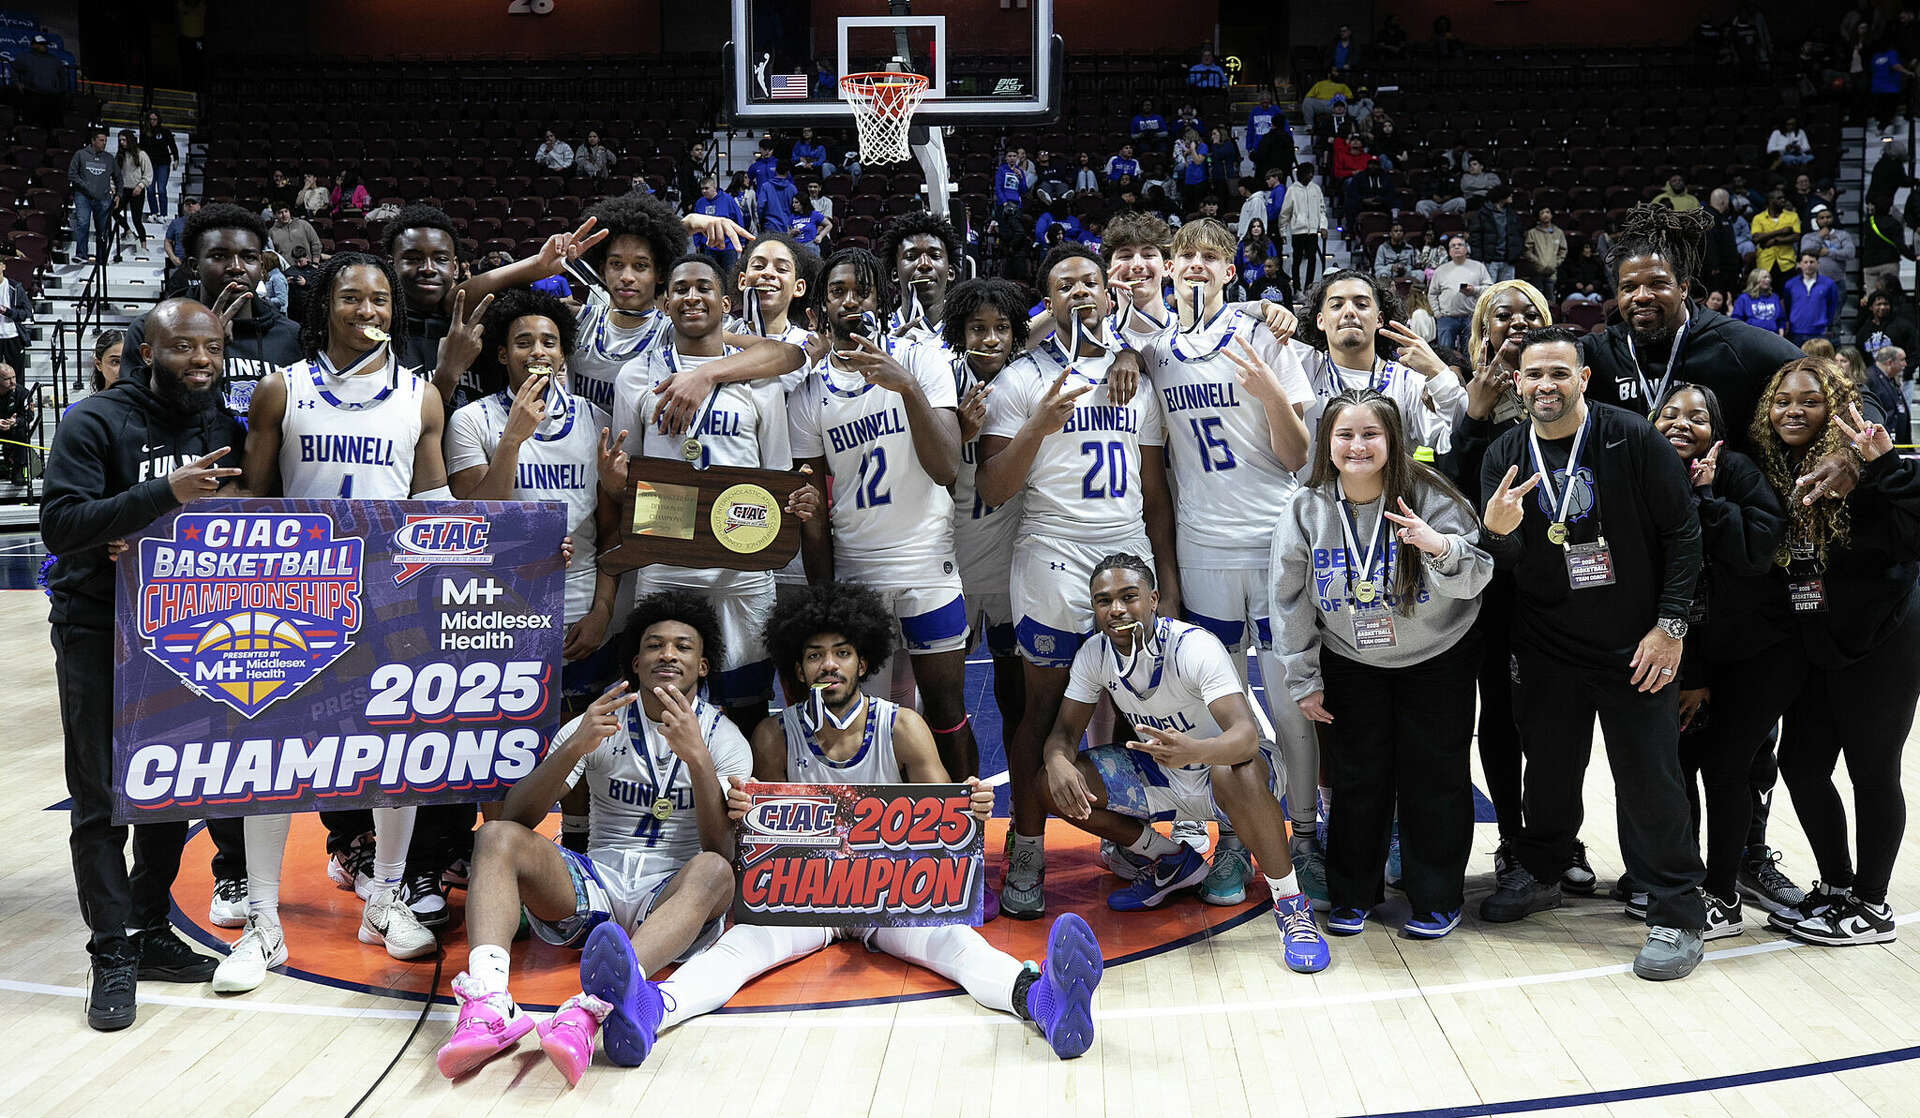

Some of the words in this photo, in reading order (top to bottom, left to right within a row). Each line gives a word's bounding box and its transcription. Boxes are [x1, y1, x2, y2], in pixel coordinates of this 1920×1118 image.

[1163, 382, 1240, 413] BUNNELL
[826, 407, 905, 454] BUNNELL
[1189, 416, 1237, 473] 15
[299, 435, 394, 467] BUNNELL
[855, 446, 892, 511] 12
[1081, 441, 1127, 500] 20
[733, 506, 768, 520] CIAC
[204, 518, 302, 548] CIAC
[410, 522, 490, 550] CIAC
[153, 546, 354, 578] BASKETBALL
[144, 581, 357, 634] CHAMPIONSHIPS
[441, 611, 552, 630] Middlesex
[1319, 598, 1341, 612] OF
[1795, 601, 1819, 611] EVENT
[223, 651, 268, 659] PRESENTED
[440, 631, 514, 650] Health
[246, 659, 306, 669] Middlesex
[246, 669, 286, 679] Health
[365, 661, 543, 716] 2025
[125, 729, 540, 800] CHAMPIONS
[632, 813, 666, 848] 4
[758, 804, 837, 831] CIAC
[849, 796, 973, 845] 2025
[742, 857, 970, 908] CHAMPION
